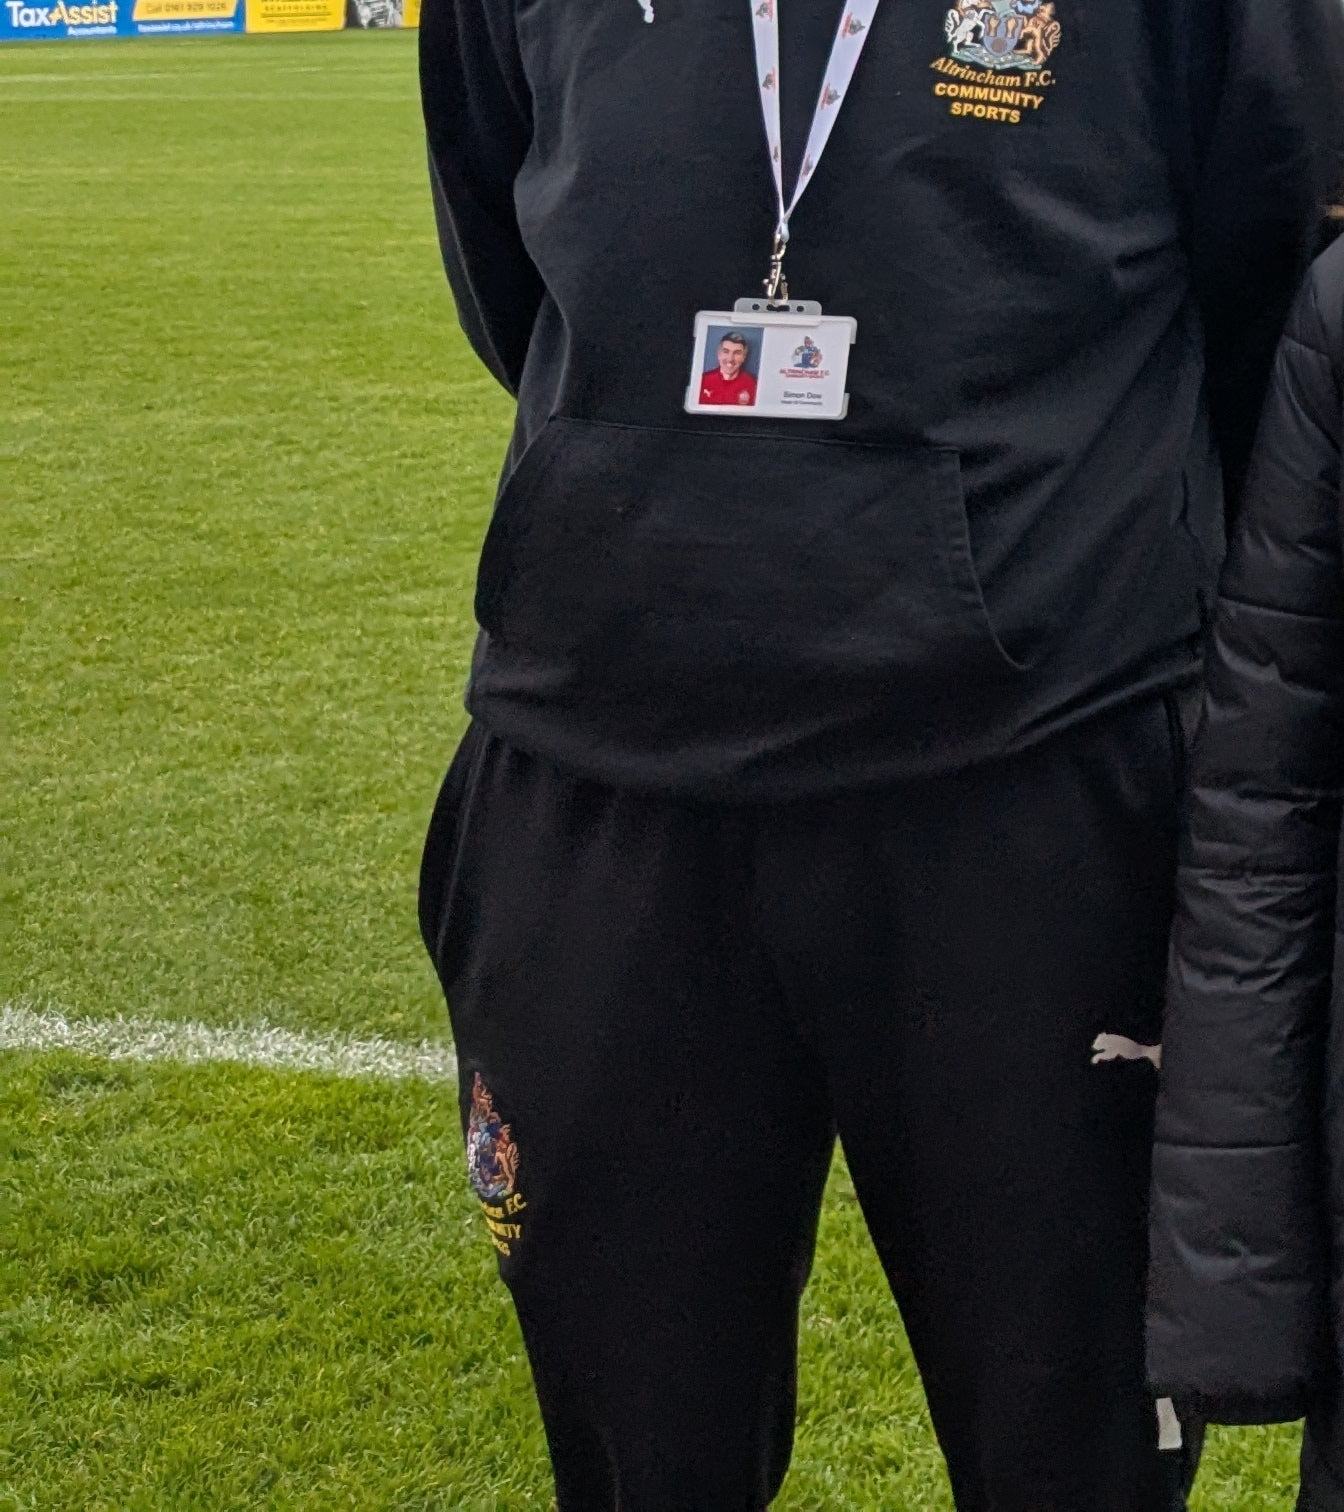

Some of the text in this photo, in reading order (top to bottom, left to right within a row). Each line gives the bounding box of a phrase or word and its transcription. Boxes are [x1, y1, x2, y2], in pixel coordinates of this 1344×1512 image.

[5, 0, 118, 27] TaxAssist
[929, 57, 1056, 87] Altrincham F.C.
[934, 82, 1045, 110] COMMUNITY
[951, 101, 1022, 124] SPORTS
